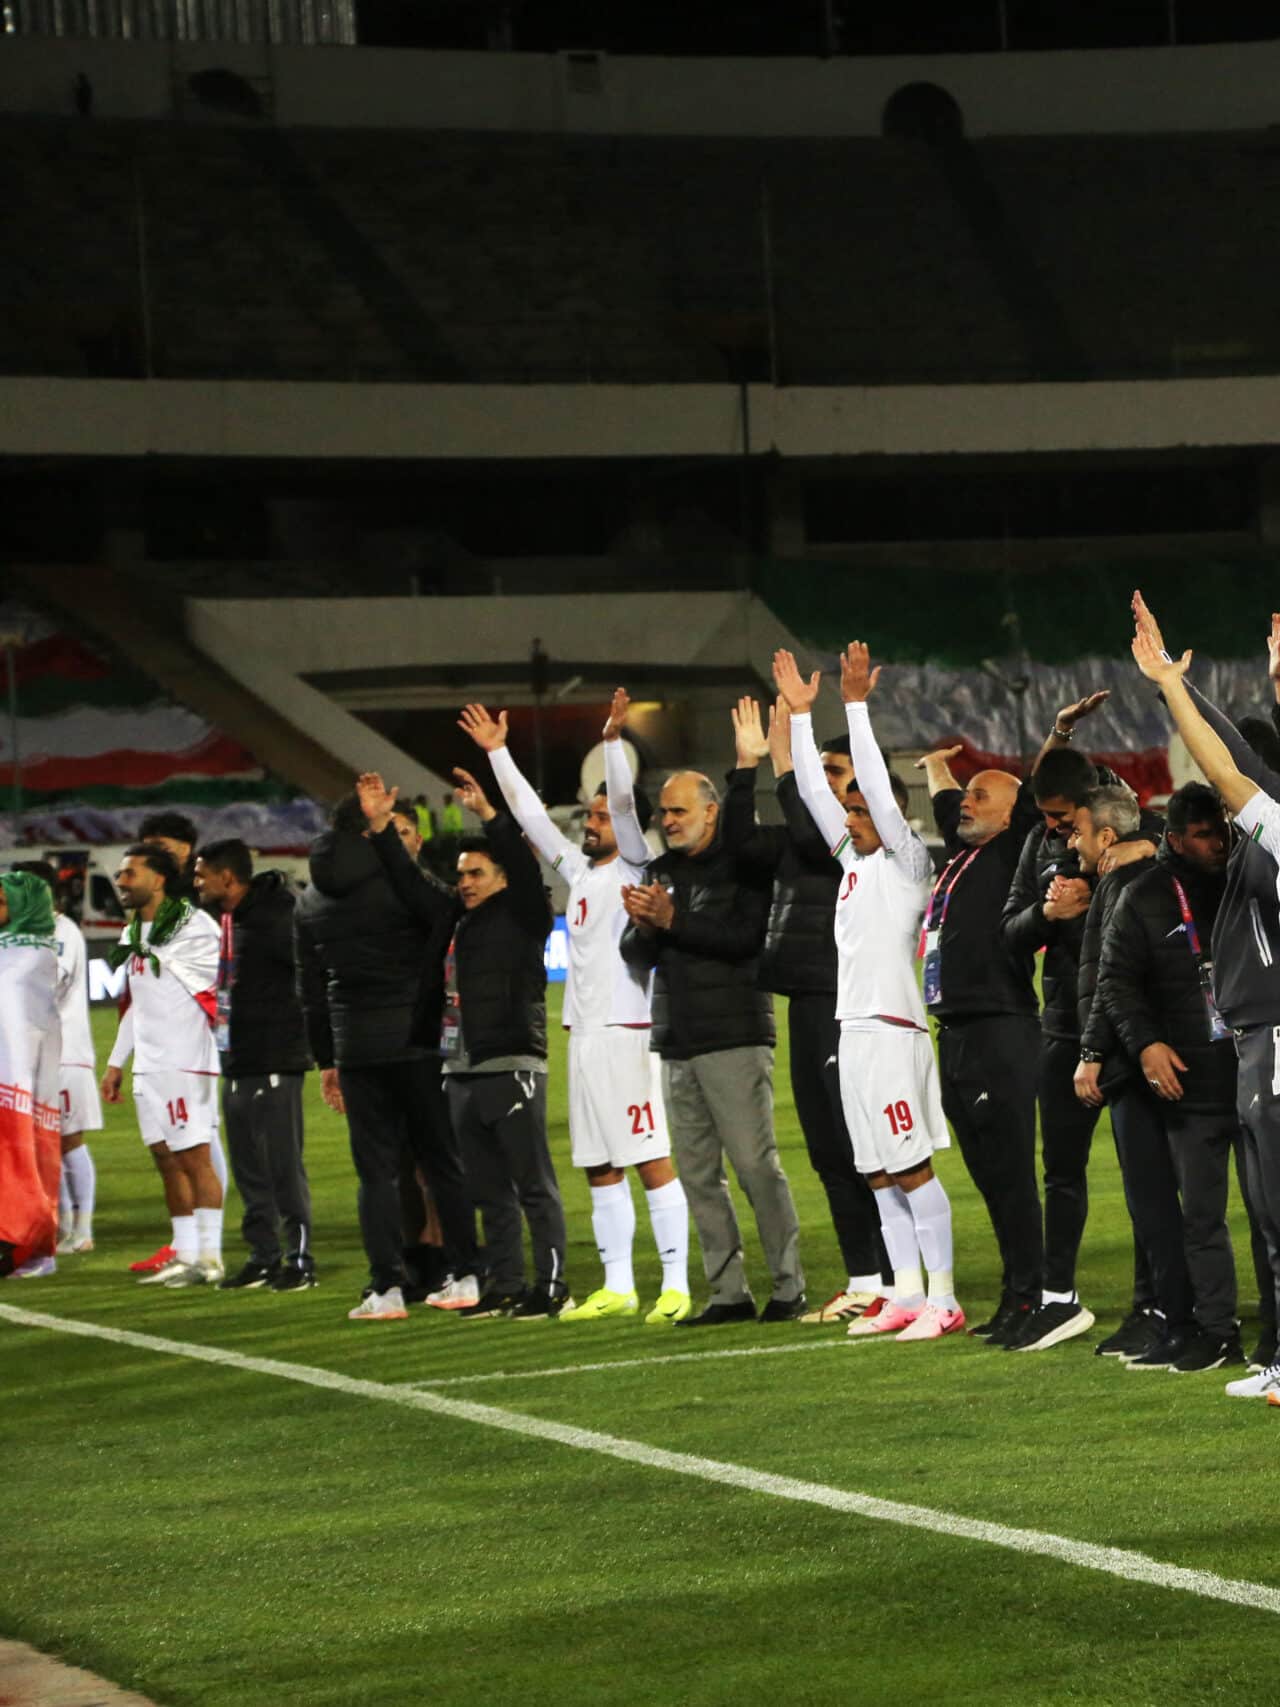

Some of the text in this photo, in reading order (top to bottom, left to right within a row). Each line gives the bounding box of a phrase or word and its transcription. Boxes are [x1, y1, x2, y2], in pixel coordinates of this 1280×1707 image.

[167, 1097, 189, 1125] 14
[627, 1102, 656, 1136] 21
[884, 1100, 914, 1136] 19
